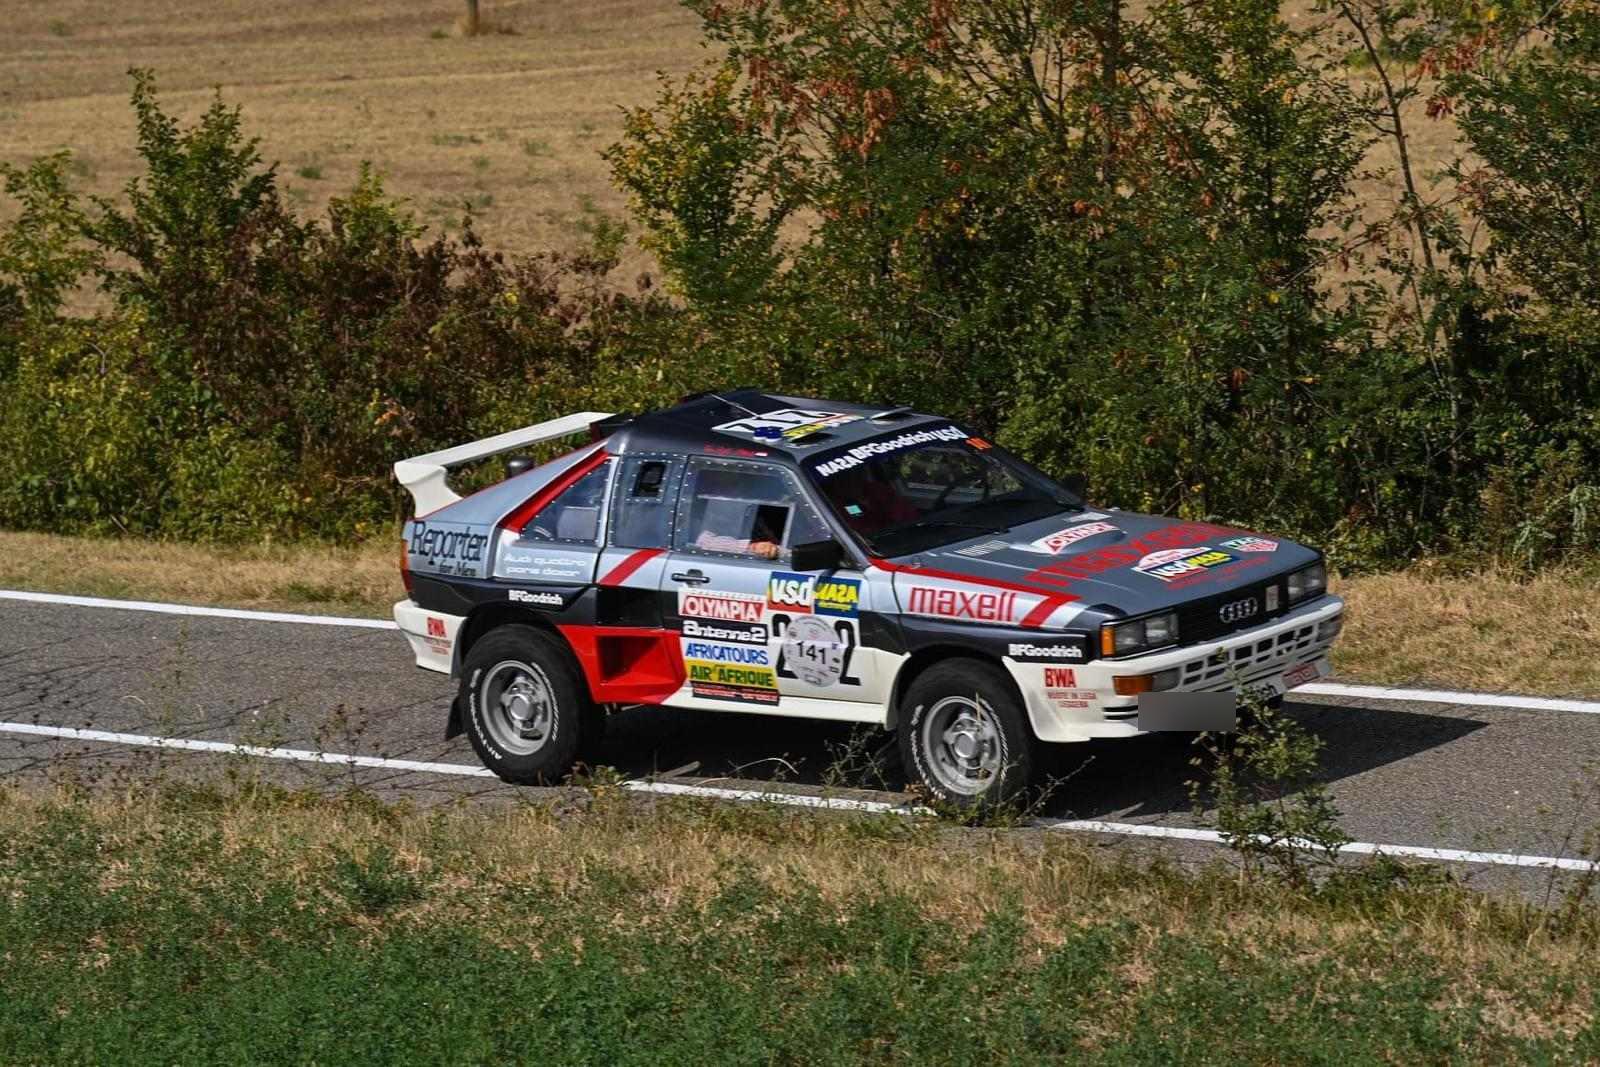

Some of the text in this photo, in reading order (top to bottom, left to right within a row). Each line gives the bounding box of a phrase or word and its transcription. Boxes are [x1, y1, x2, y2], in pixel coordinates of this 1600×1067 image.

[848, 431, 937, 459] BFGoodrich
[408, 521, 488, 566] Reporter
[508, 590, 563, 605] BFGoodrich
[685, 597, 759, 622] OLYMPIA
[909, 586, 1017, 622] maxell
[685, 642, 769, 666] AFRICATOURS
[797, 641, 827, 665] 141
[1008, 643, 1083, 659] BFGoodrich
[690, 665, 712, 681] AIR
[719, 667, 774, 687] AFRIQUE
[1044, 668, 1077, 688] BWA
